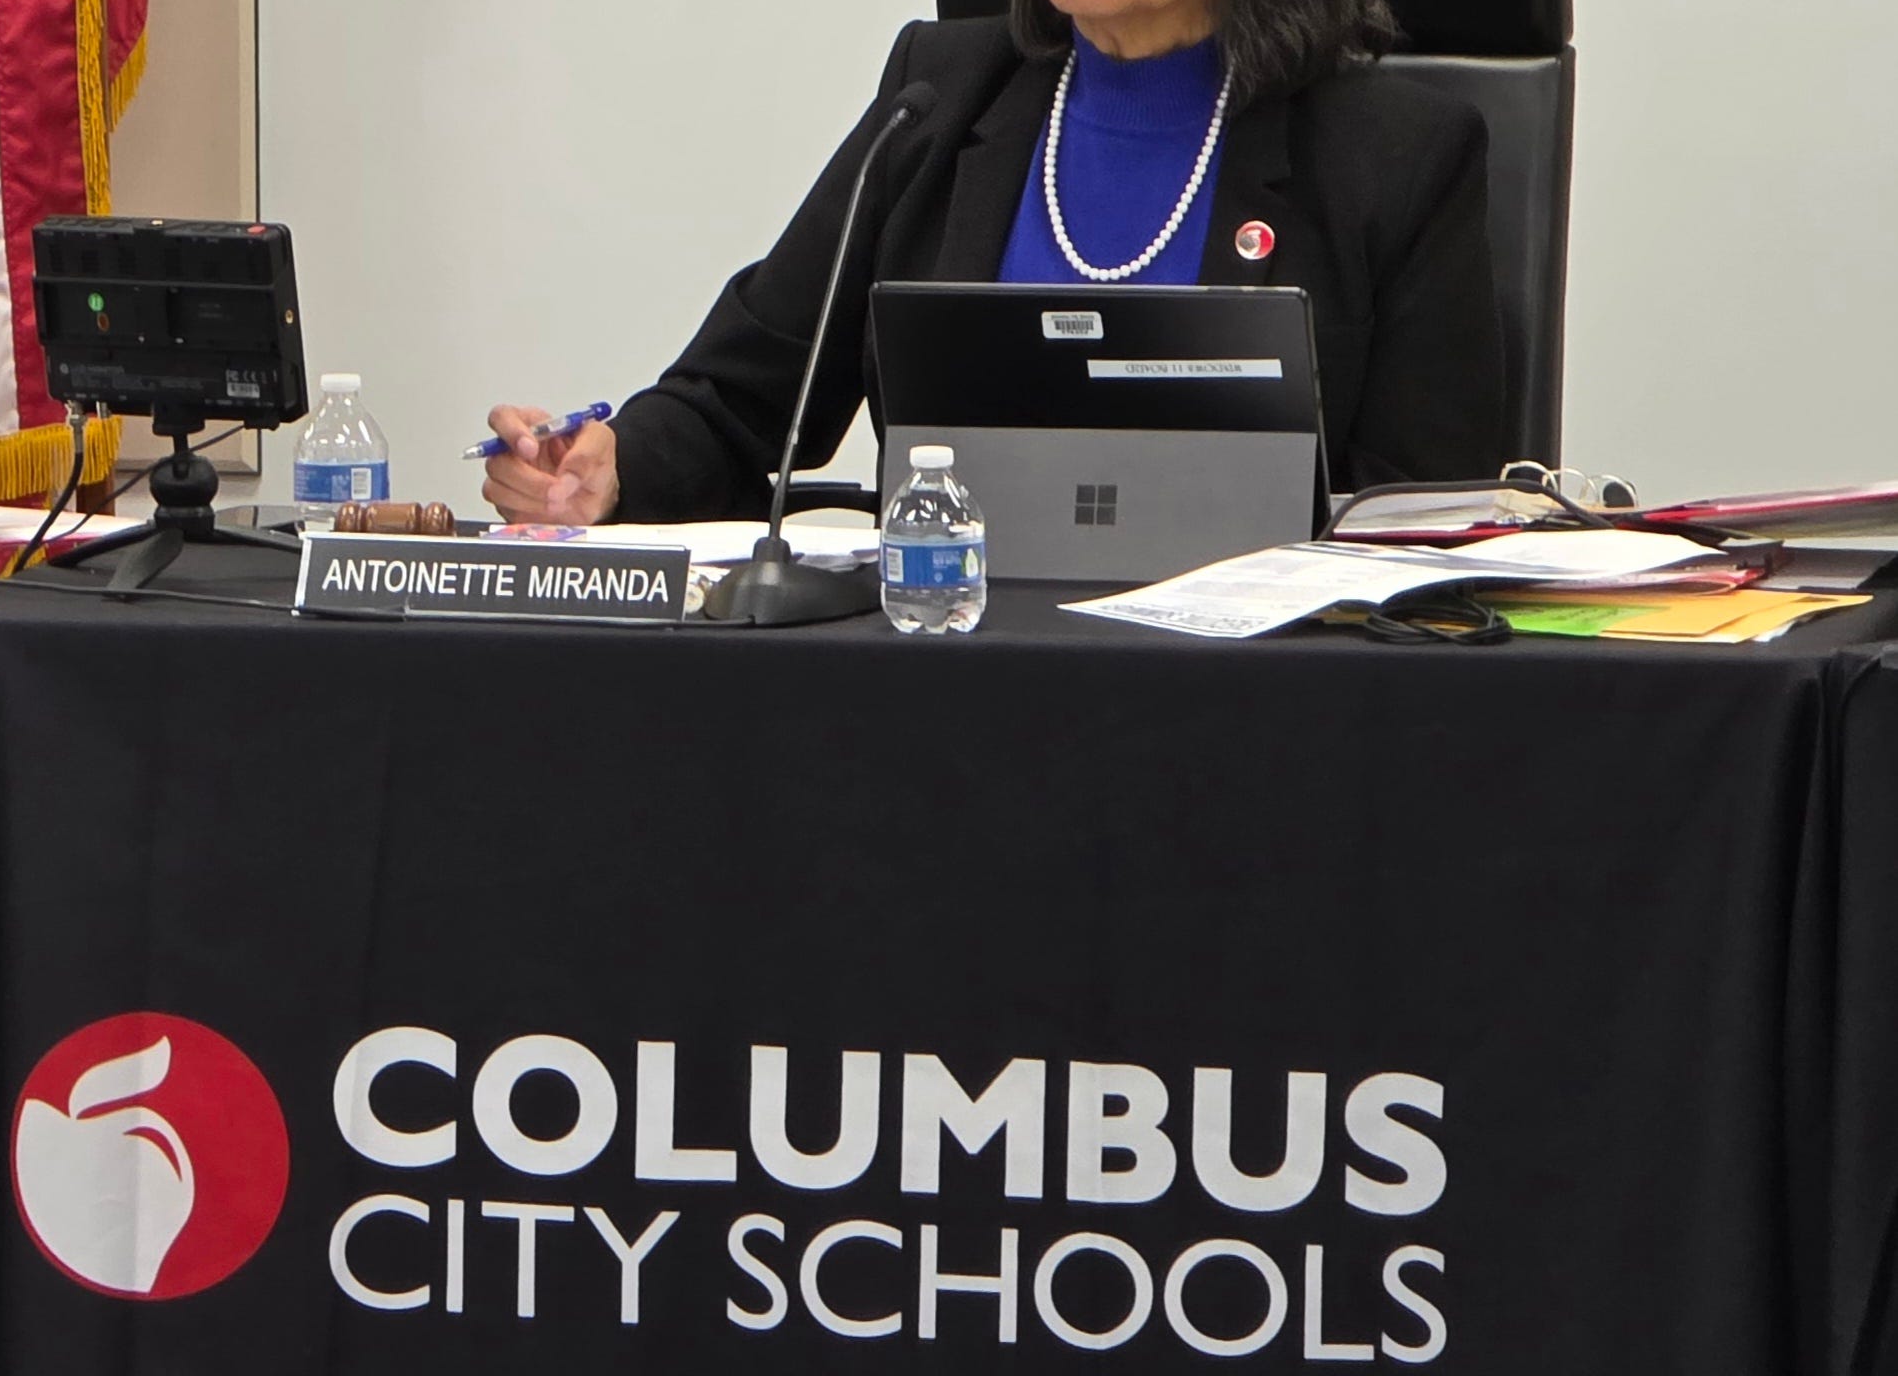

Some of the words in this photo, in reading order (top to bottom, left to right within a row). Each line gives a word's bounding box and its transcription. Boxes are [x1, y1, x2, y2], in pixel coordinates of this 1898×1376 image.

[321, 558, 517, 597] ANTOINETTE
[527, 565, 669, 604] MIRANDA
[332, 1025, 1448, 1217] COLUMBUS
[327, 1193, 681, 1325] CITY
[726, 1212, 1448, 1364] SCHOOLS
